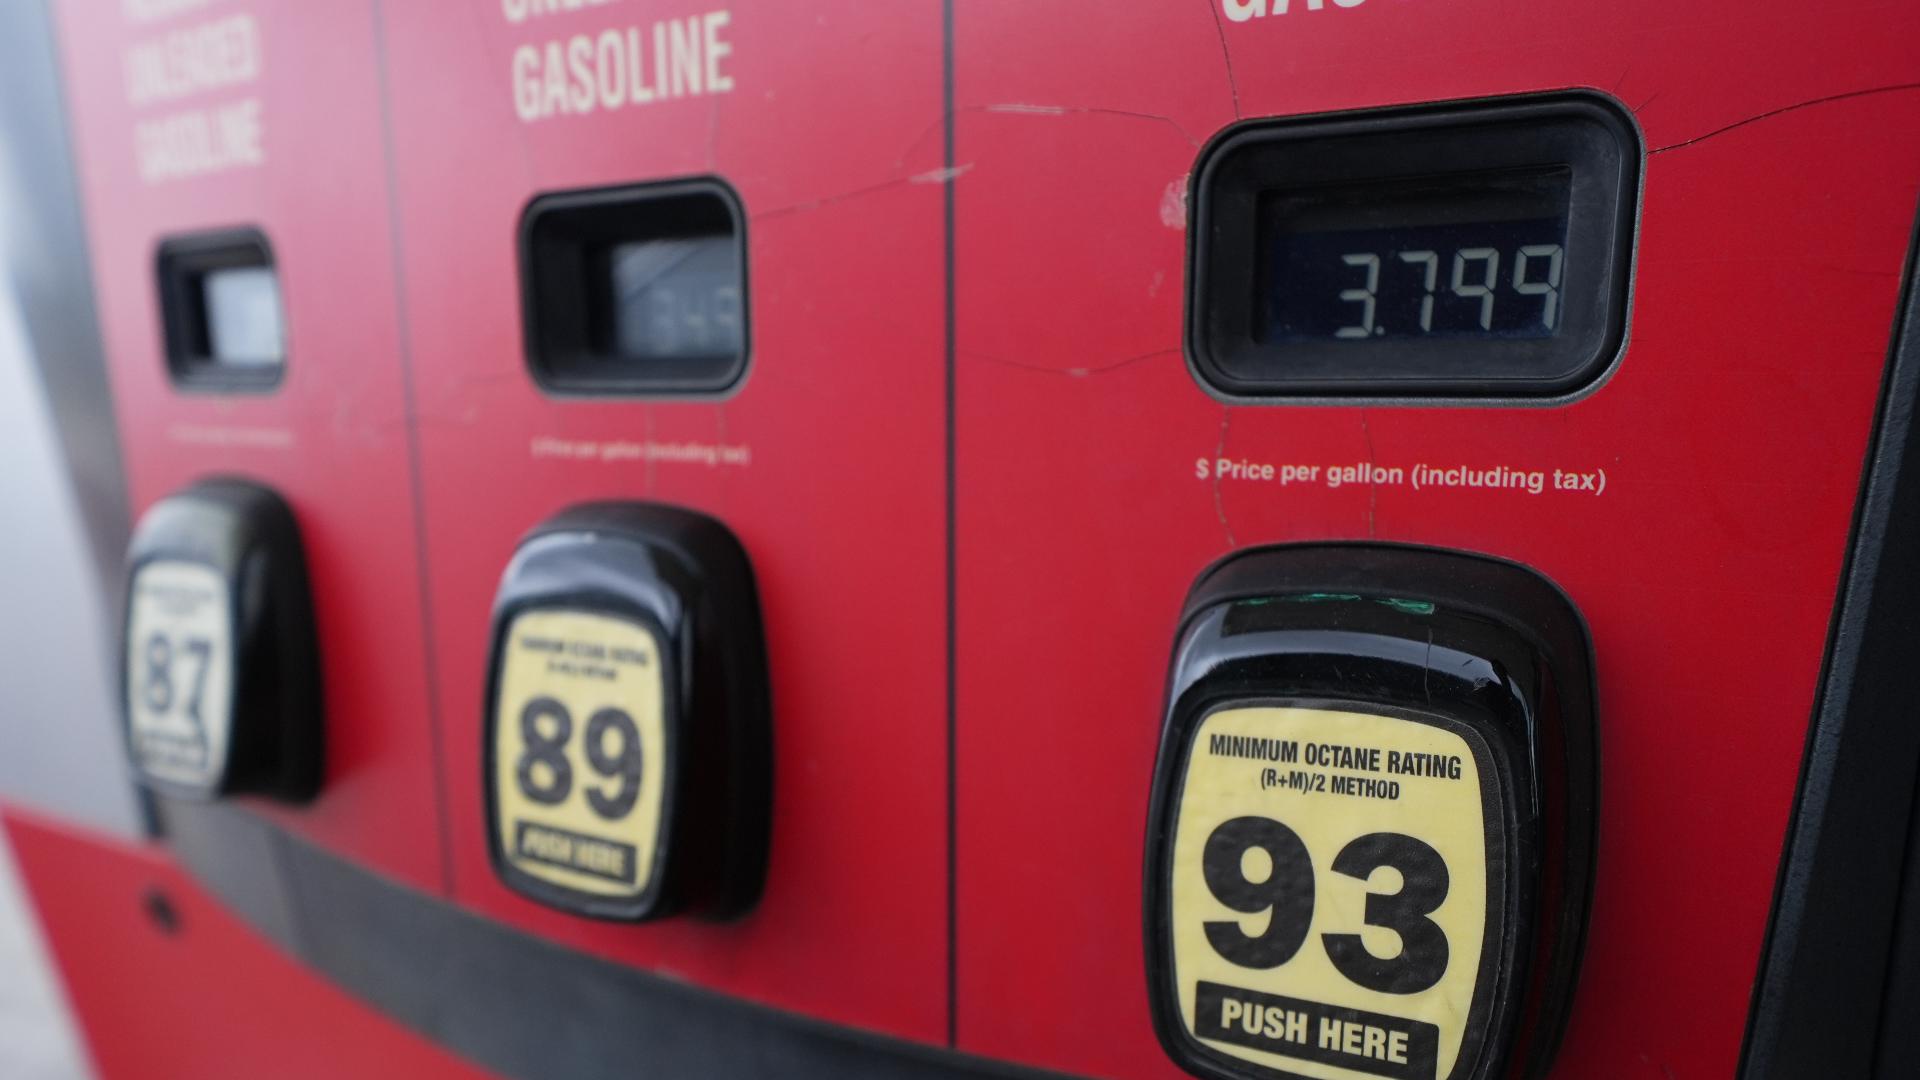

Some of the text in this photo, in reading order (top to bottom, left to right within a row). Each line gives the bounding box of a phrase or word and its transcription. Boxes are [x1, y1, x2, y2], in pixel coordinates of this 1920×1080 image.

[513, 10, 735, 122] GASOLINE
[1334, 244, 1564, 338] 3.799
[1195, 458, 1606, 496] $ Price per gallon (including tax)
[147, 630, 211, 716] 87
[517, 695, 642, 822] 89
[1210, 734, 1461, 780] MINIMUM OCTANE RATING
[1261, 767, 1399, 800] (R+M)/2 METHOD
[1202, 815, 1450, 995] 93
[1221, 998, 1408, 1064] PUSH HERE
